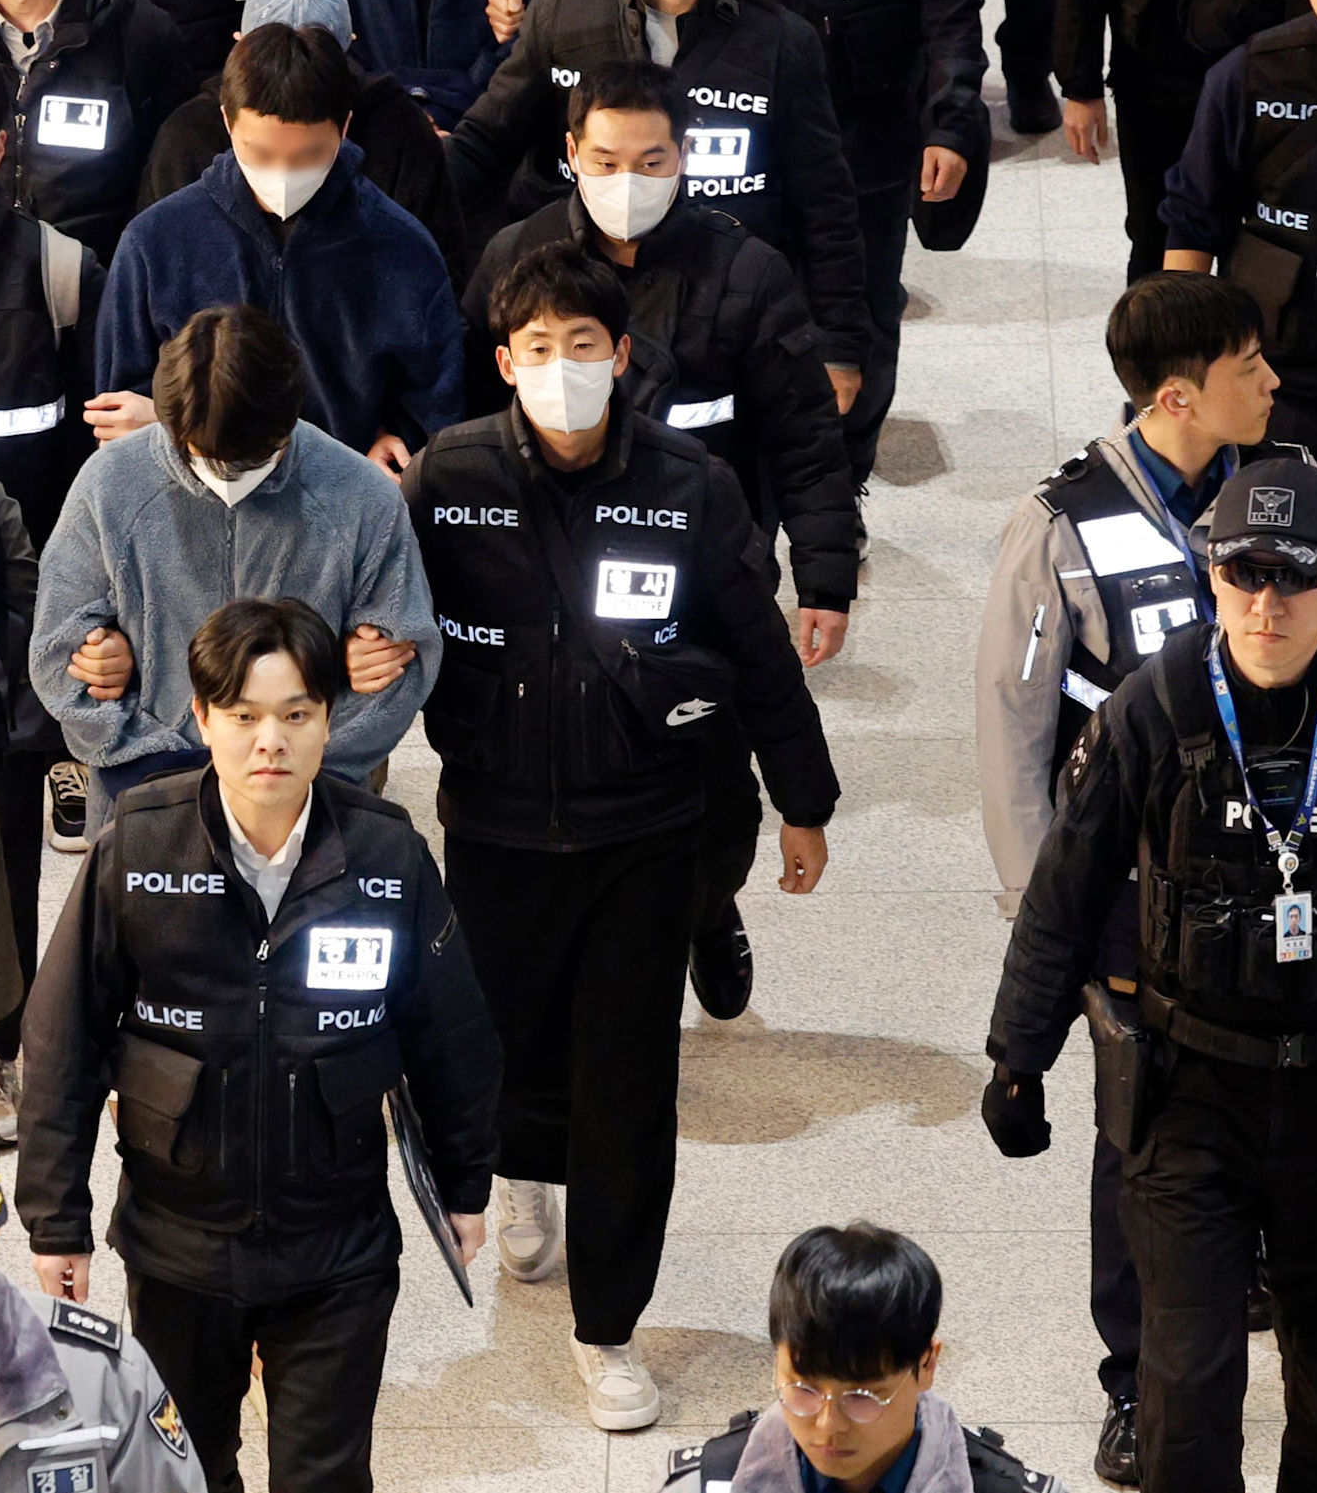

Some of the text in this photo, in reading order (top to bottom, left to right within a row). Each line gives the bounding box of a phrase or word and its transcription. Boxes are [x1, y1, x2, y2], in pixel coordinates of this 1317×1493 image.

[687, 173, 766, 198] POLICE
[434, 507, 519, 528] POLICE
[595, 505, 688, 531] POLICE
[609, 569, 665, 595] 형사
[438, 613, 506, 647] POLICE
[125, 872, 226, 895] POLICE
[321, 938, 380, 963] 경찰
